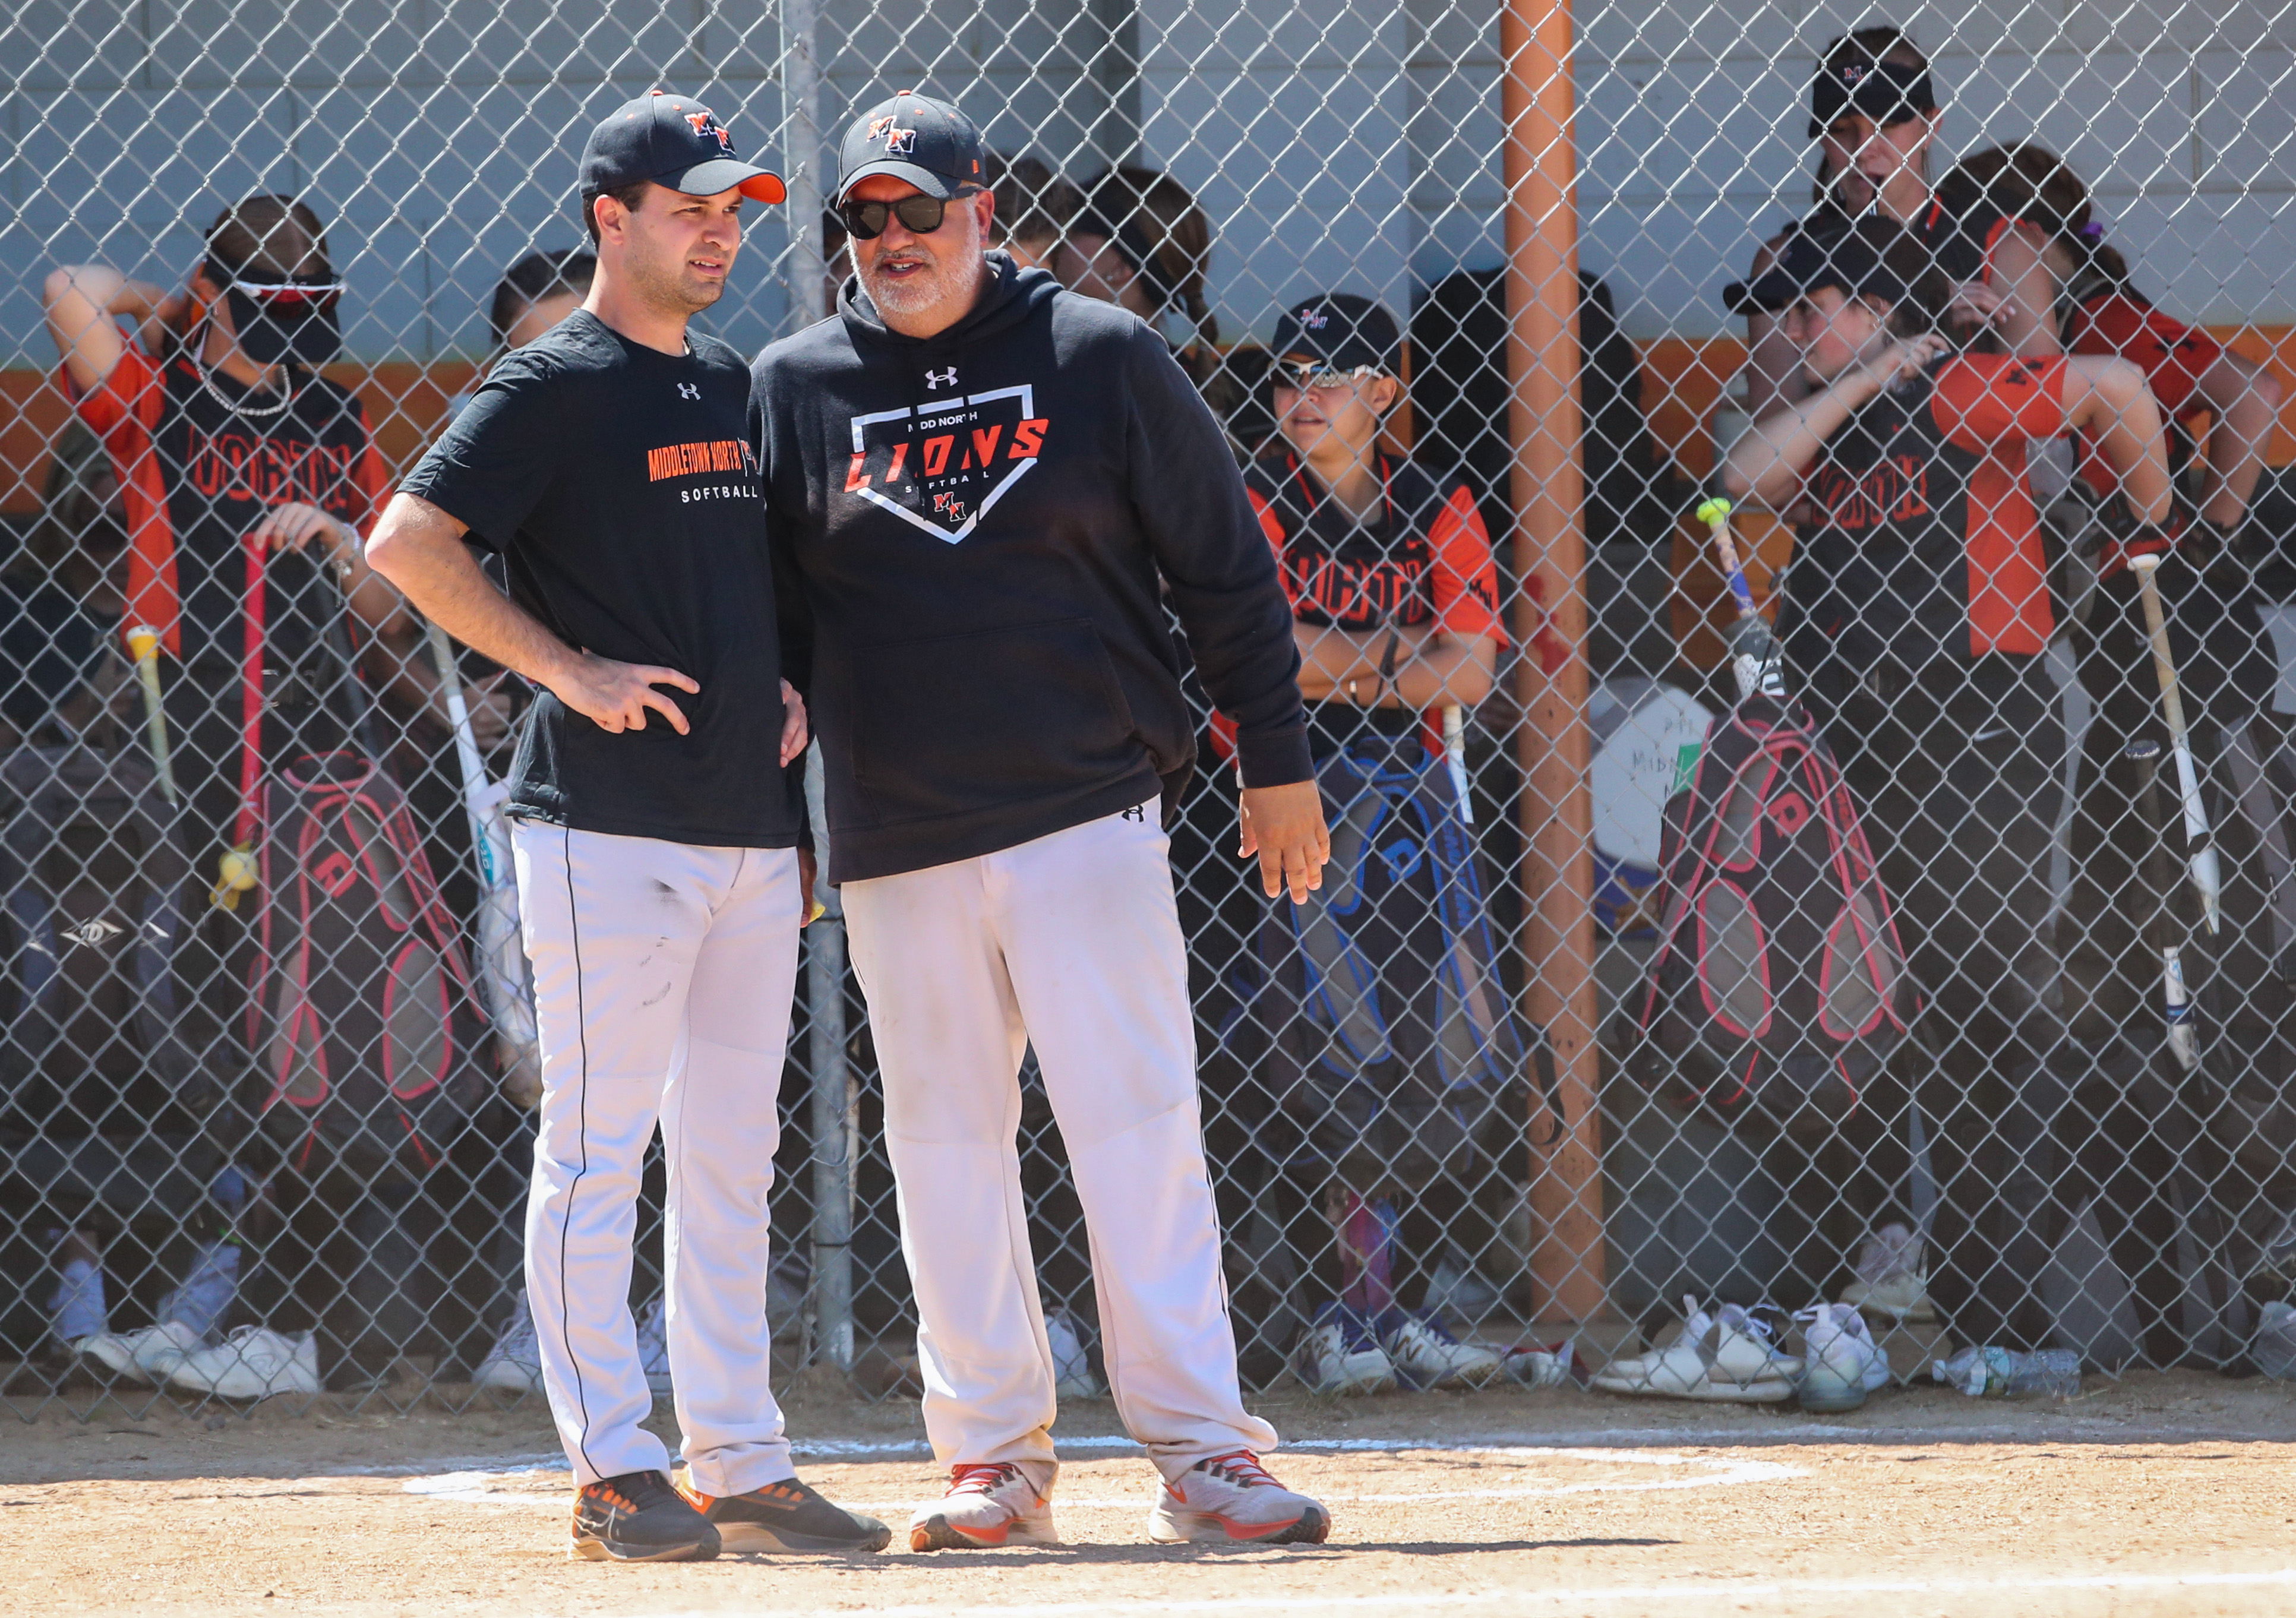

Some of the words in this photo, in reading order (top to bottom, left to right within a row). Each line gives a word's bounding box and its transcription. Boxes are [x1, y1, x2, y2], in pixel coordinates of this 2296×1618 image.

[866, 115, 917, 154] MN
[648, 442, 711, 482] MIDDLETOWN
[710, 440, 741, 472] NORTH
[844, 418, 1050, 493] LIONS
[681, 485, 758, 504] SOFTBALL
[933, 491, 967, 522] MN
